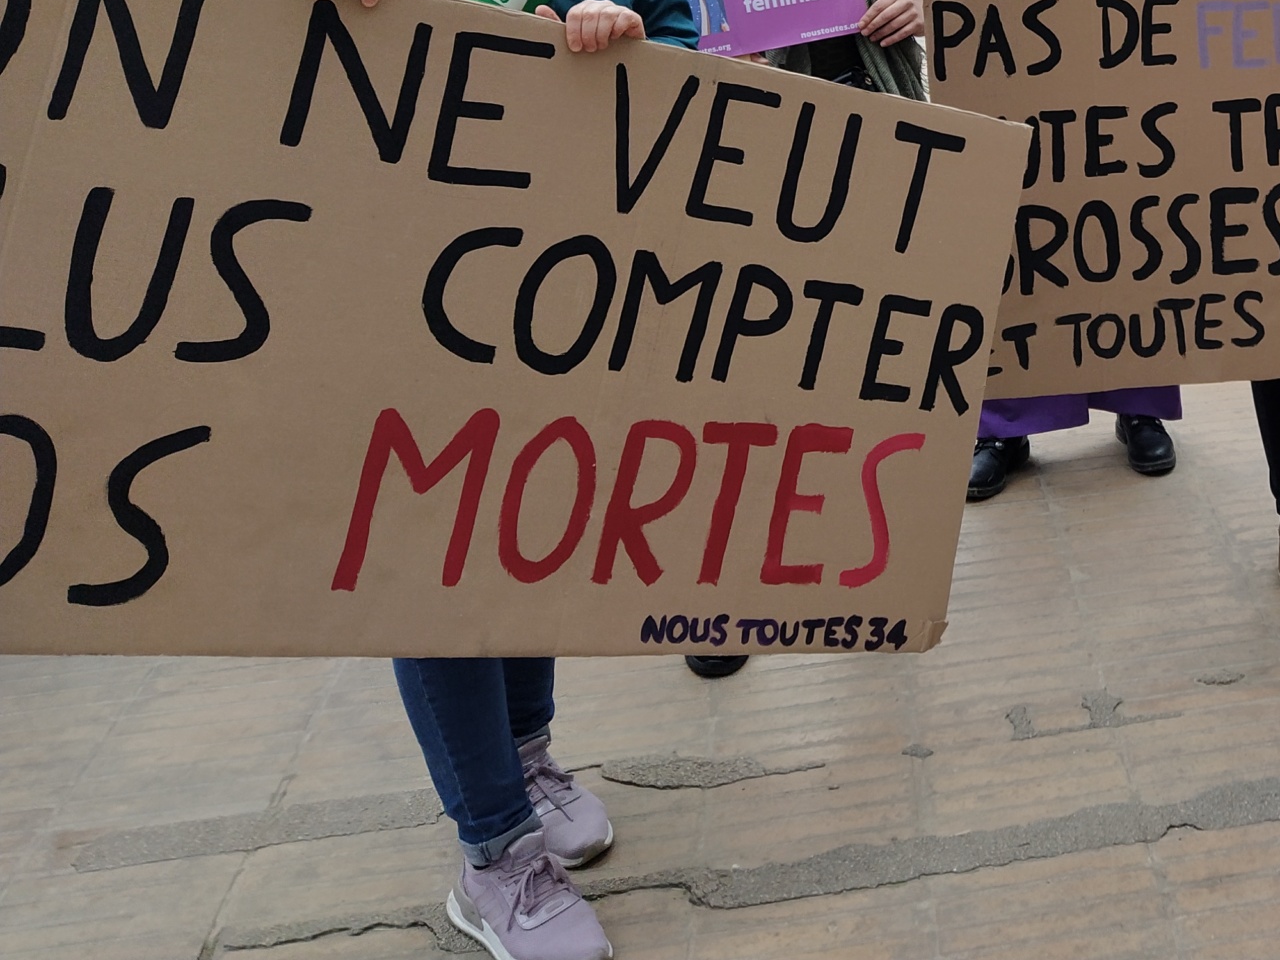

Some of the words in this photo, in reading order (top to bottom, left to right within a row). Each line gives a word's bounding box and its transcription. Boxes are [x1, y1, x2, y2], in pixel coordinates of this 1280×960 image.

[280, 0, 555, 189] NE
[615, 63, 965, 254] VEUT
[421, 227, 984, 416] COMPTER
[987, 322, 1037, 377] T
[1054, 290, 1265, 368] TOUTES
[330, 408, 925, 592] MORTES
[640, 613, 730, 647] NOUS
[735, 614, 863, 649] TOUTES
[864, 617, 908, 652] 34
